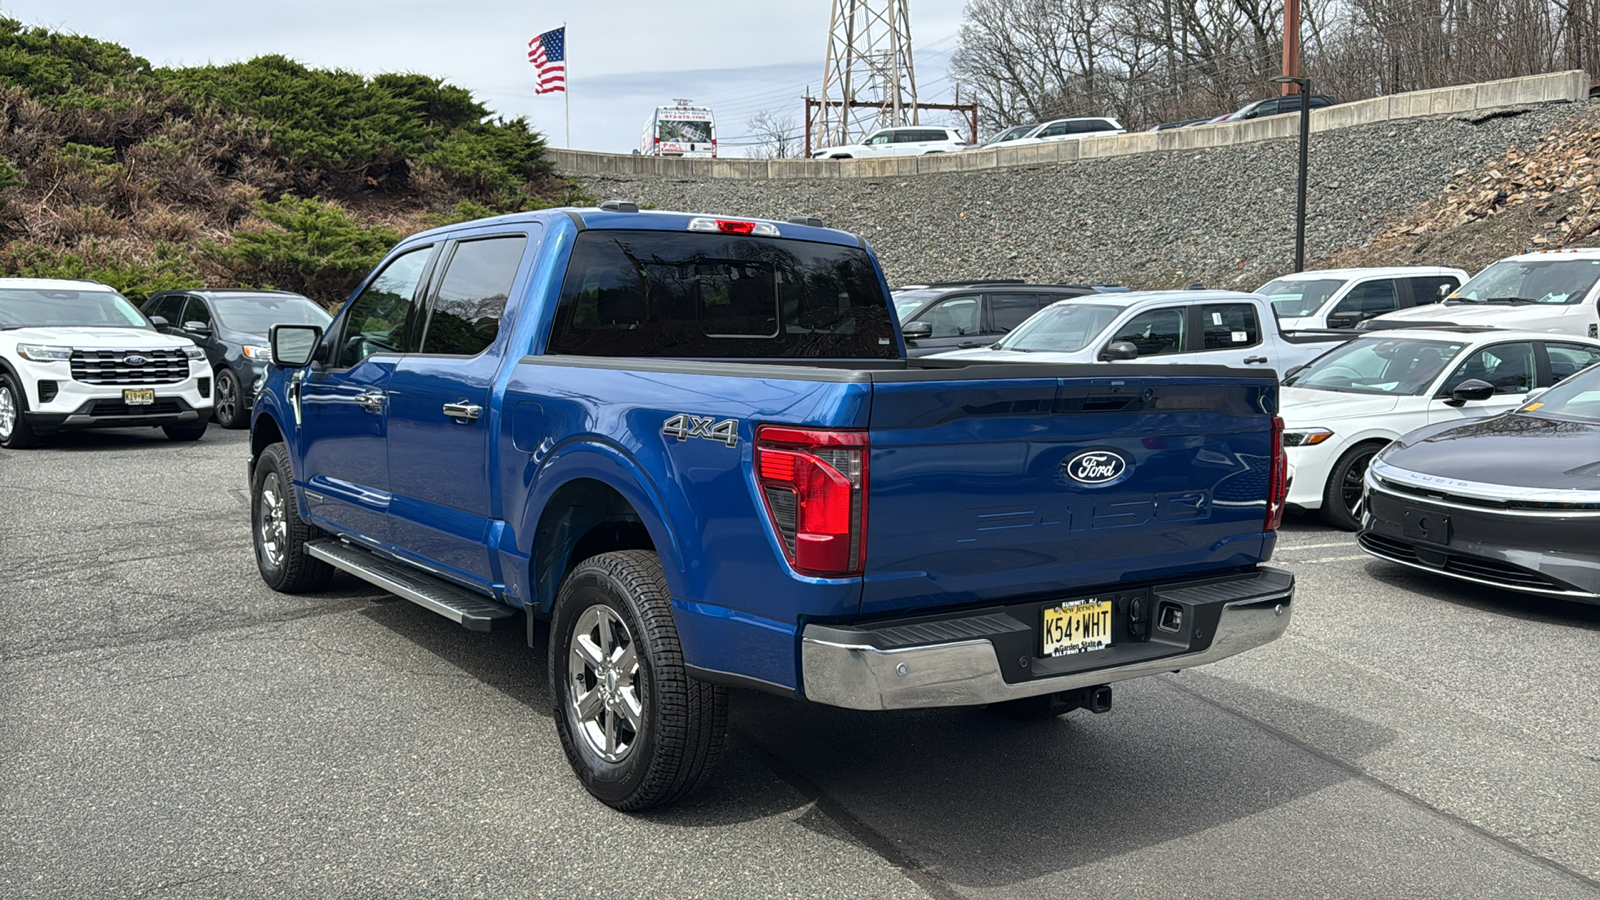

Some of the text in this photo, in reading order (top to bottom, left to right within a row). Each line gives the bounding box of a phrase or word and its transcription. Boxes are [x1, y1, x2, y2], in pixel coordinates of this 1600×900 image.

[1078, 456, 1116, 478] Ford
[1411, 474, 1468, 487] LUCID
[957, 489, 1212, 543] F-150
[1059, 604, 1096, 614] New Jersey
[1046, 610, 1109, 645] K54 WHT
[1059, 640, 1096, 651] Garden State
